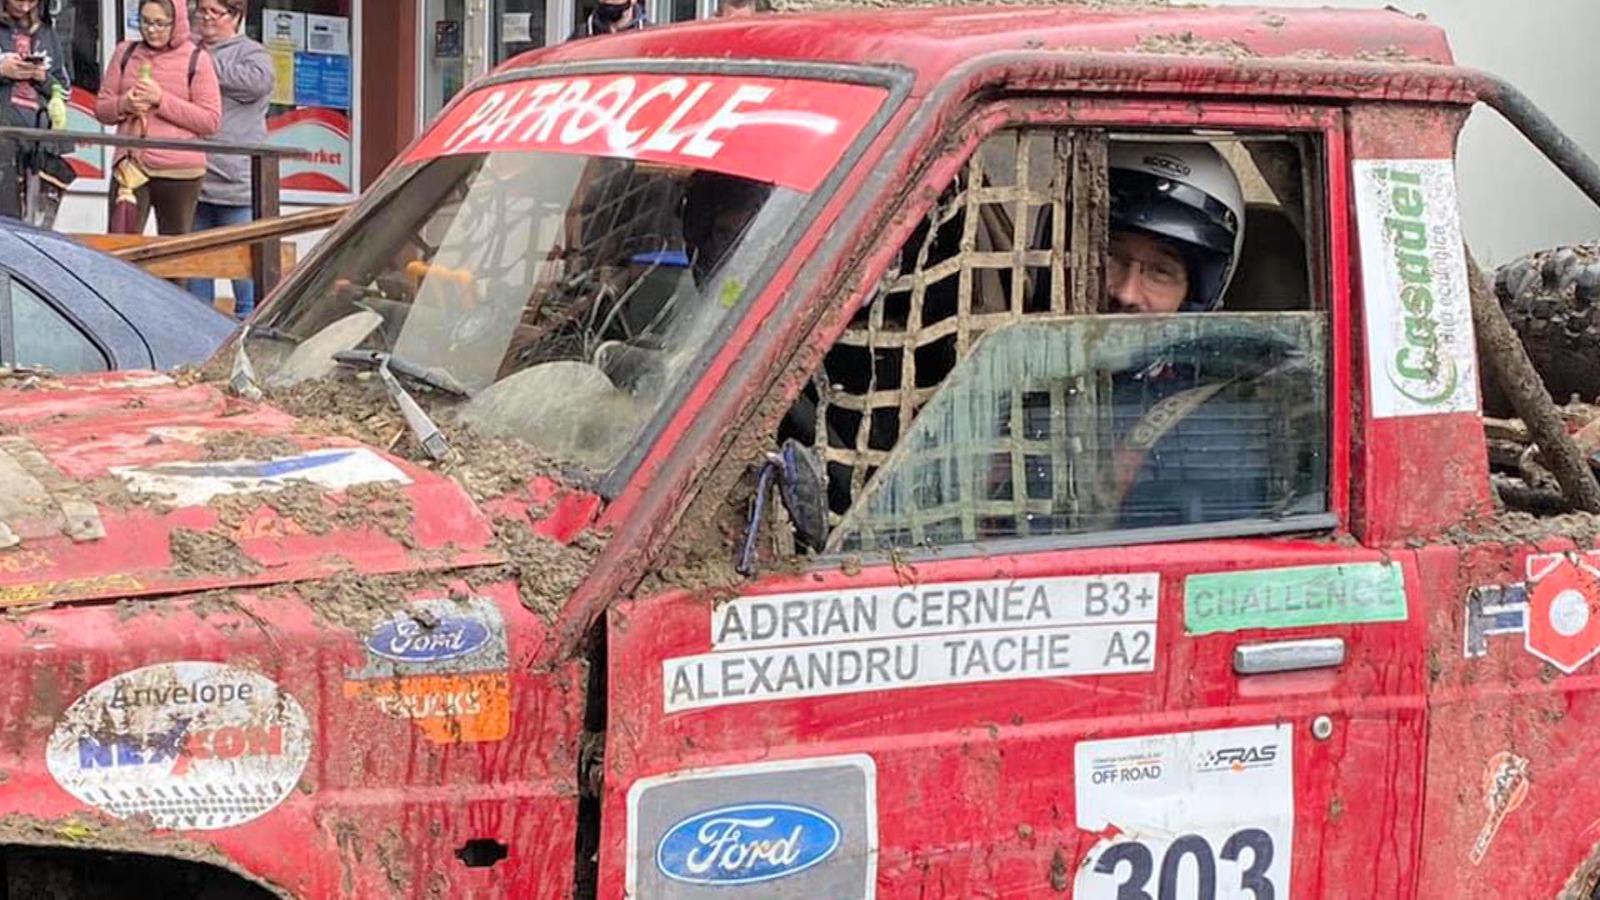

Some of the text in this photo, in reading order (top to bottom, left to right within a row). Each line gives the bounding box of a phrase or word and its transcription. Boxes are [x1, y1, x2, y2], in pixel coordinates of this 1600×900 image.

[443, 74, 774, 158] PATROCLE
[718, 581, 1154, 643] ADRIAN CERNEA B3+
[111, 681, 253, 709] Anvelope
[669, 630, 1151, 704] ALEXANDRU TACHE A2
[1092, 765, 1161, 785] OFF ROAD
[1214, 745, 1277, 765] FRAS
[687, 816, 803, 873] Ford
[1093, 828, 1275, 900] 303
